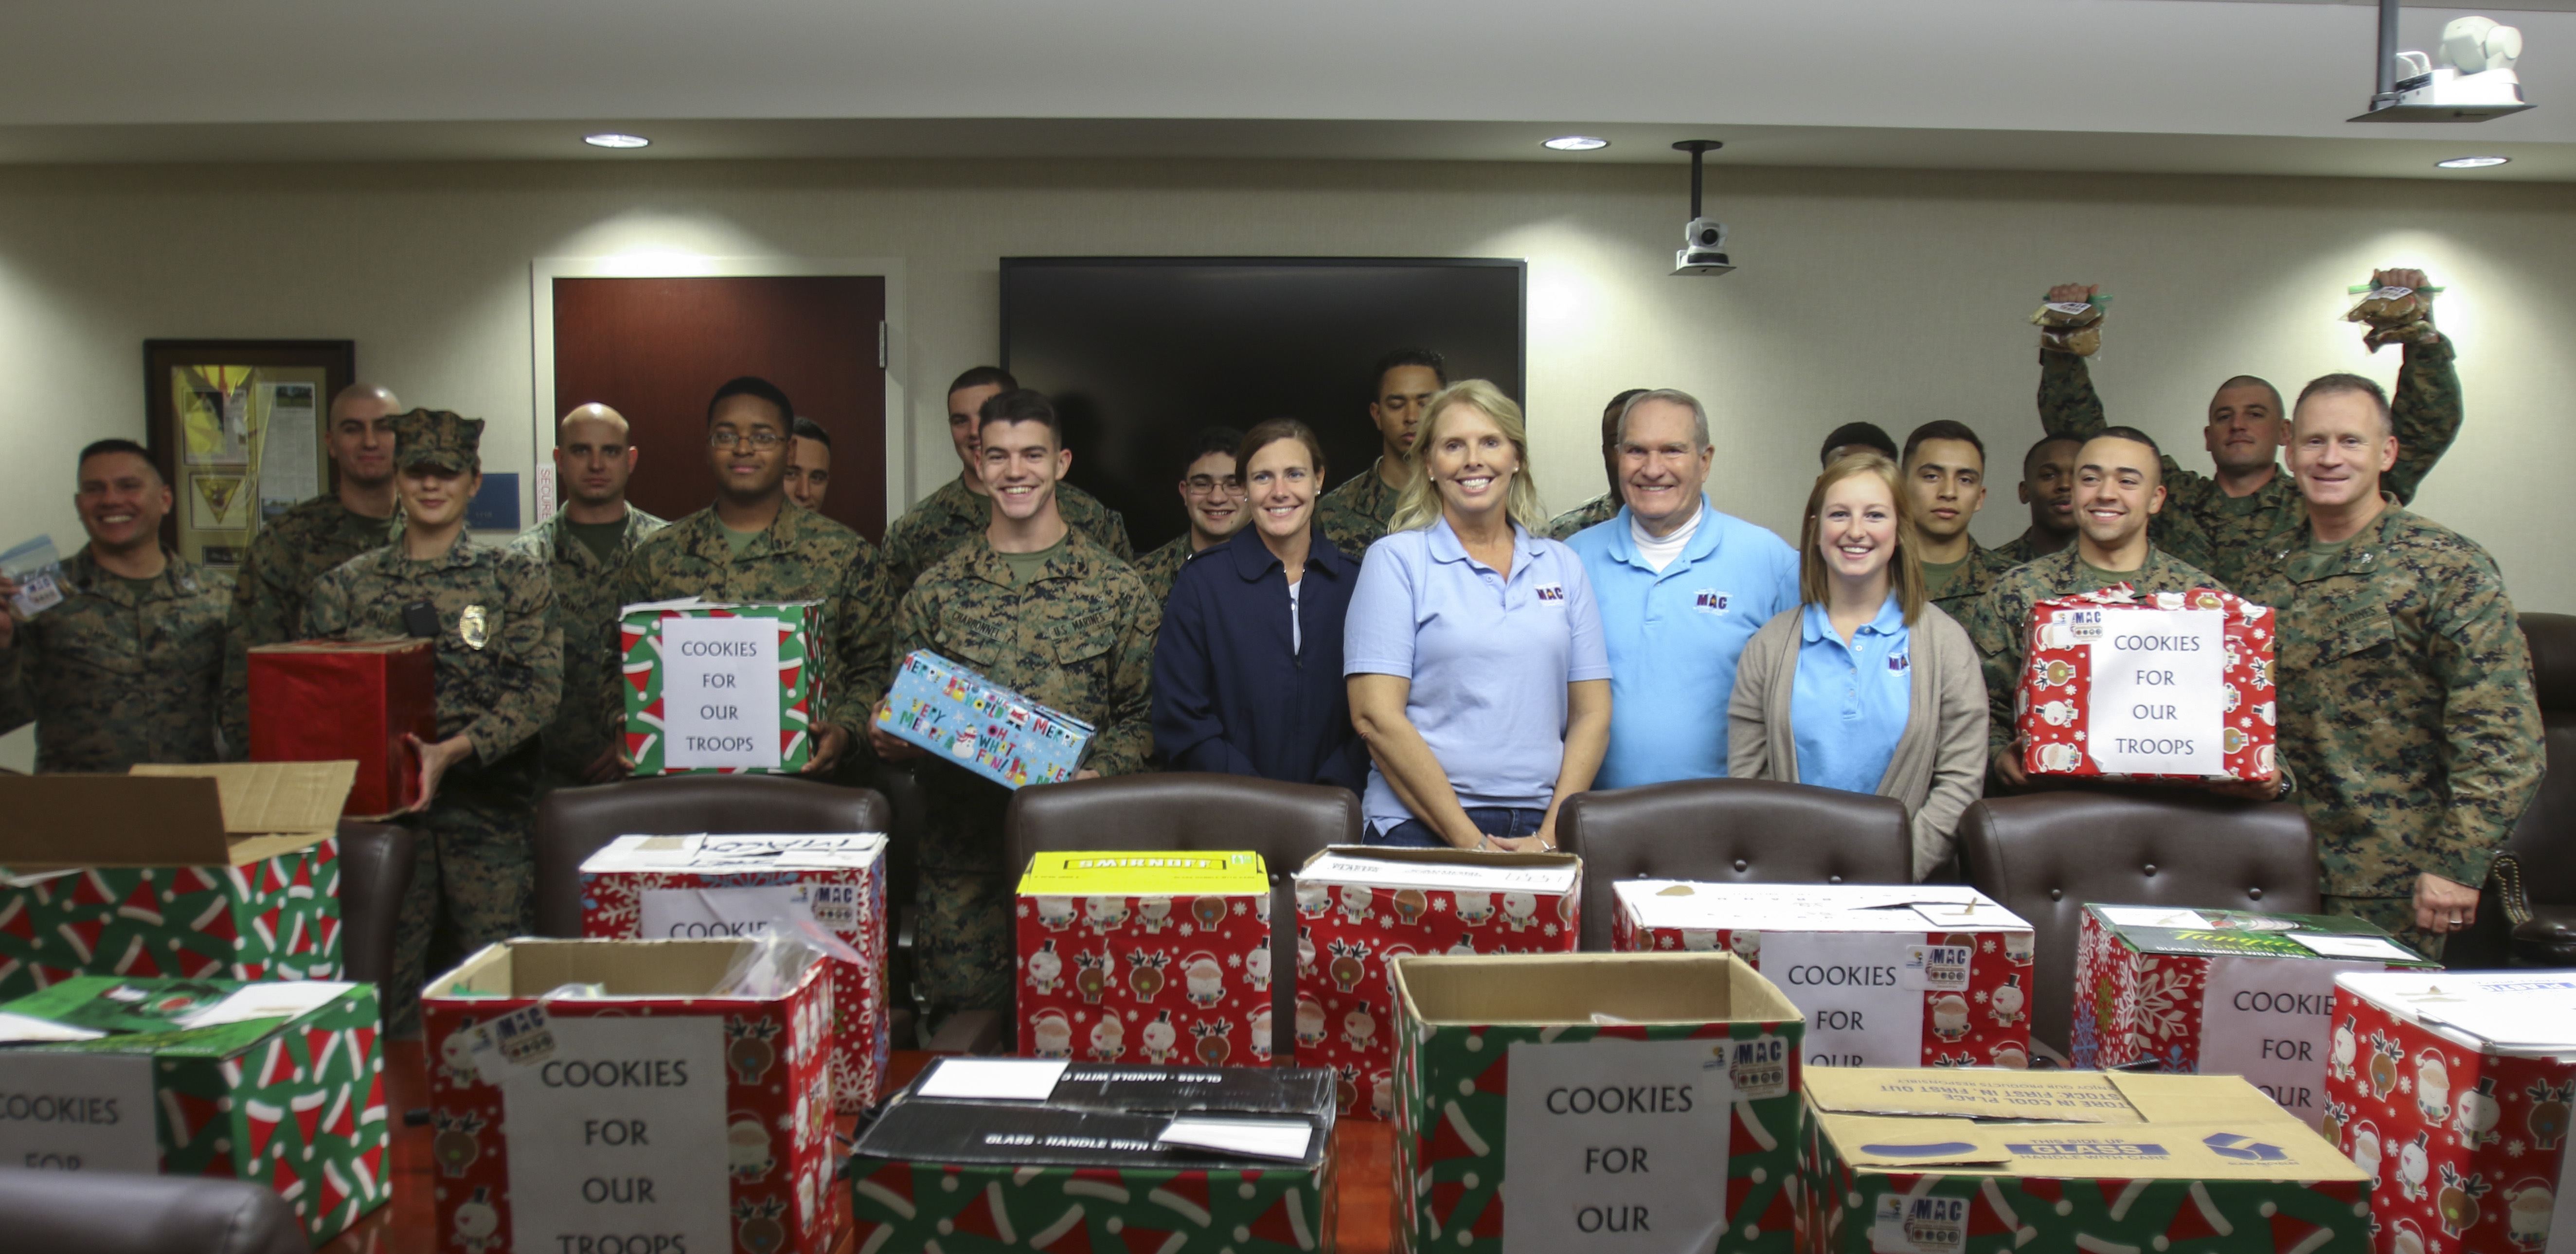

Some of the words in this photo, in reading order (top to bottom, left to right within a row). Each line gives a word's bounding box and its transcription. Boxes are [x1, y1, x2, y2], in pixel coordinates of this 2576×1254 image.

[1536, 587, 1564, 600] MAC
[1696, 593, 1728, 609] MAC
[1072, 612, 1105, 631] MARINES
[2075, 611, 2101, 624] MAC
[681, 641, 757, 657] COOKIES
[2114, 635, 2200, 652] COOKIES
[904, 655, 946, 683] MERRY
[1889, 655, 1909, 670] MA
[702, 673, 736, 689] FOR
[2136, 670, 2176, 686] FOR
[700, 704, 738, 720] OUR
[911, 697, 946, 723] VERY
[965, 694, 1004, 718] WORLD
[2133, 705, 2178, 720] OUR
[899, 710, 947, 742] MERRY
[987, 724, 1008, 741] OH
[1032, 717, 1083, 748] MERRY
[686, 735, 753, 752] TROOPS
[979, 734, 1017, 757] WHAT
[2116, 738, 2195, 755] TROOPS
[975, 749, 1009, 772] FUN!
[1078, 858, 1211, 868] SMIRNOFF
[820, 887, 852, 903] MAC
[670, 922, 767, 938] COOK
[1934, 949, 1966, 964] MAC
[1789, 965, 1896, 987] COOKIES
[2234, 991, 2334, 1016] COOKIE
[498, 1007, 544, 1039] MAC
[1815, 1010, 1864, 1031] FOR
[1739, 1041, 1782, 1064] MAC
[2262, 1039, 2312, 1061] FOR
[1810, 1055, 1863, 1068] OUR
[541, 1059, 688, 1088] COOKIES
[1074, 1072, 1109, 1081] WITH
[1111, 1073, 1167, 1082] HANDLE
[1920, 1086, 1968, 1094] FIRST
[1546, 1085, 1693, 1116] COOKIES
[1945, 1094, 1998, 1104] PLACE
[2004, 1097, 2052, 1106] COOL
[2079, 1100, 2129, 1109] TORE
[0, 1094, 119, 1125] OOKIES
[585, 1118, 649, 1147] FOR
[985, 1134, 1035, 1146] GLASS
[1045, 1136, 1107, 1149] HANDLE
[1110, 1139, 1149, 1151] WITH
[2031, 1145, 2144, 1155] GLASS
[1585, 1147, 1648, 1174] FOR
[581, 1177, 656, 1204] OUR
[1916, 1200, 1963, 1221] MAC
[1576, 1205, 1651, 1234] OUR
[557, 1233, 686, 1254] TROOPS
